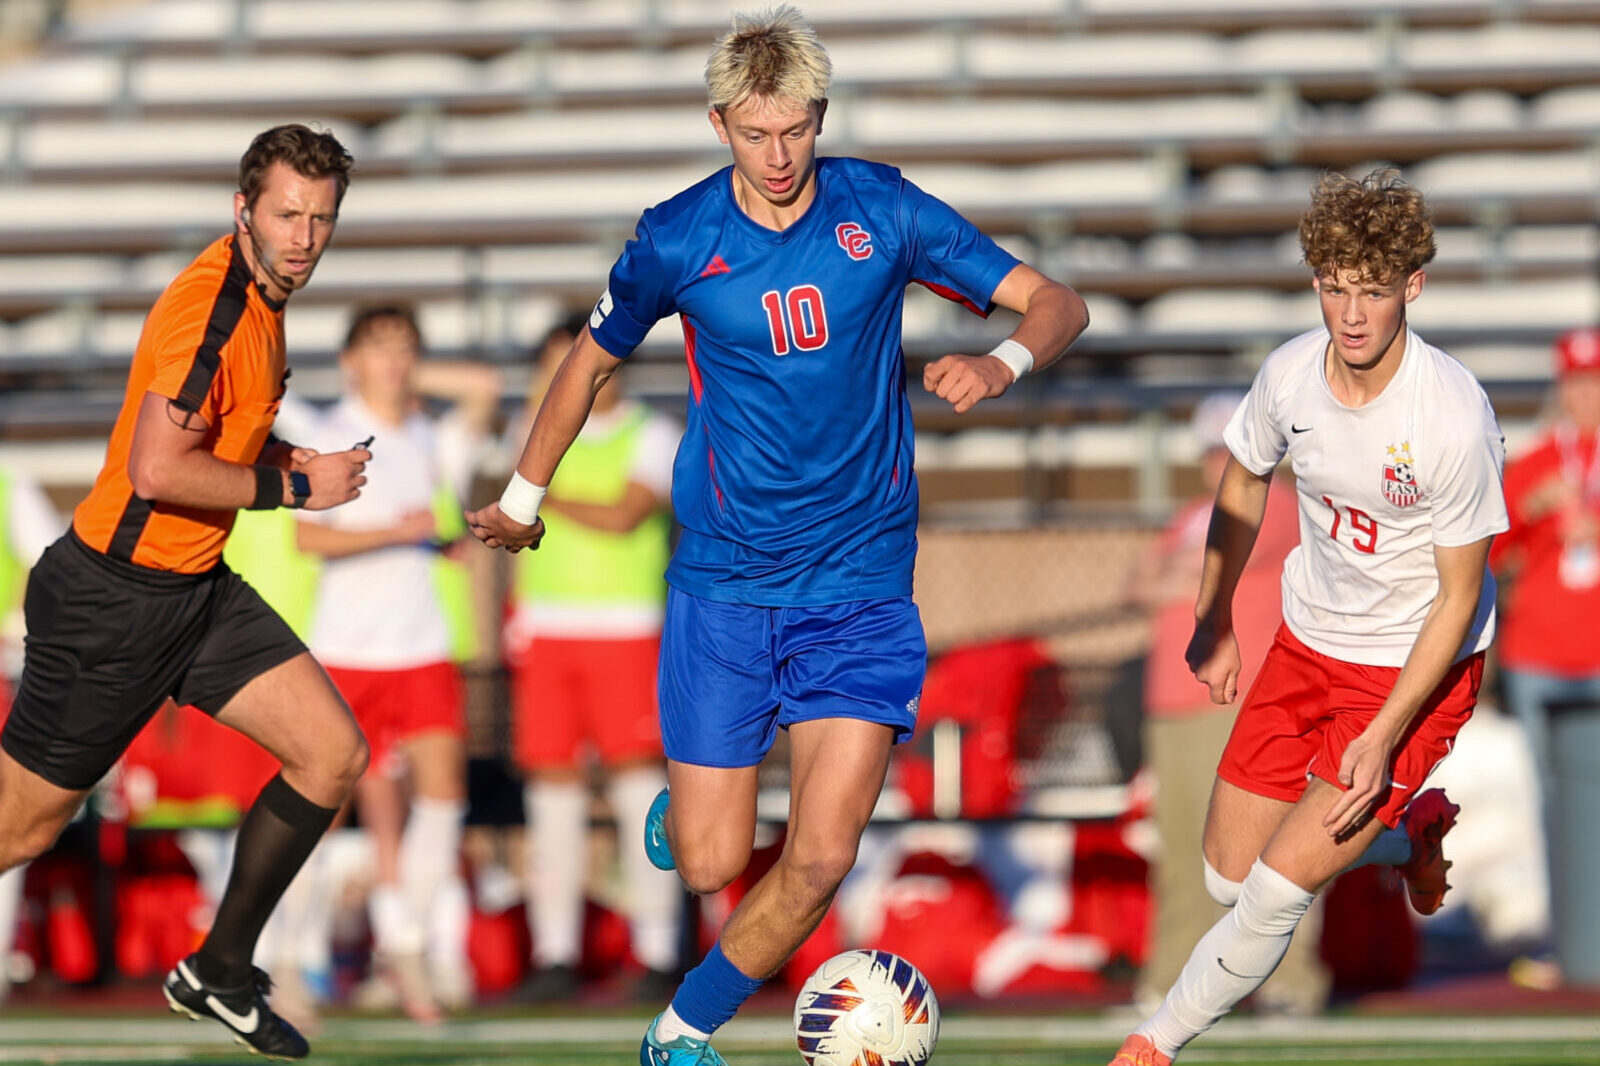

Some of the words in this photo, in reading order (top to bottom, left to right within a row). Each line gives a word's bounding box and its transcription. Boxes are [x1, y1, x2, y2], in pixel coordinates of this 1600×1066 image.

[835, 221, 873, 261] CC
[761, 284, 829, 356] 10
[1386, 480, 1420, 495] EAST
[1322, 494, 1378, 555] 19
